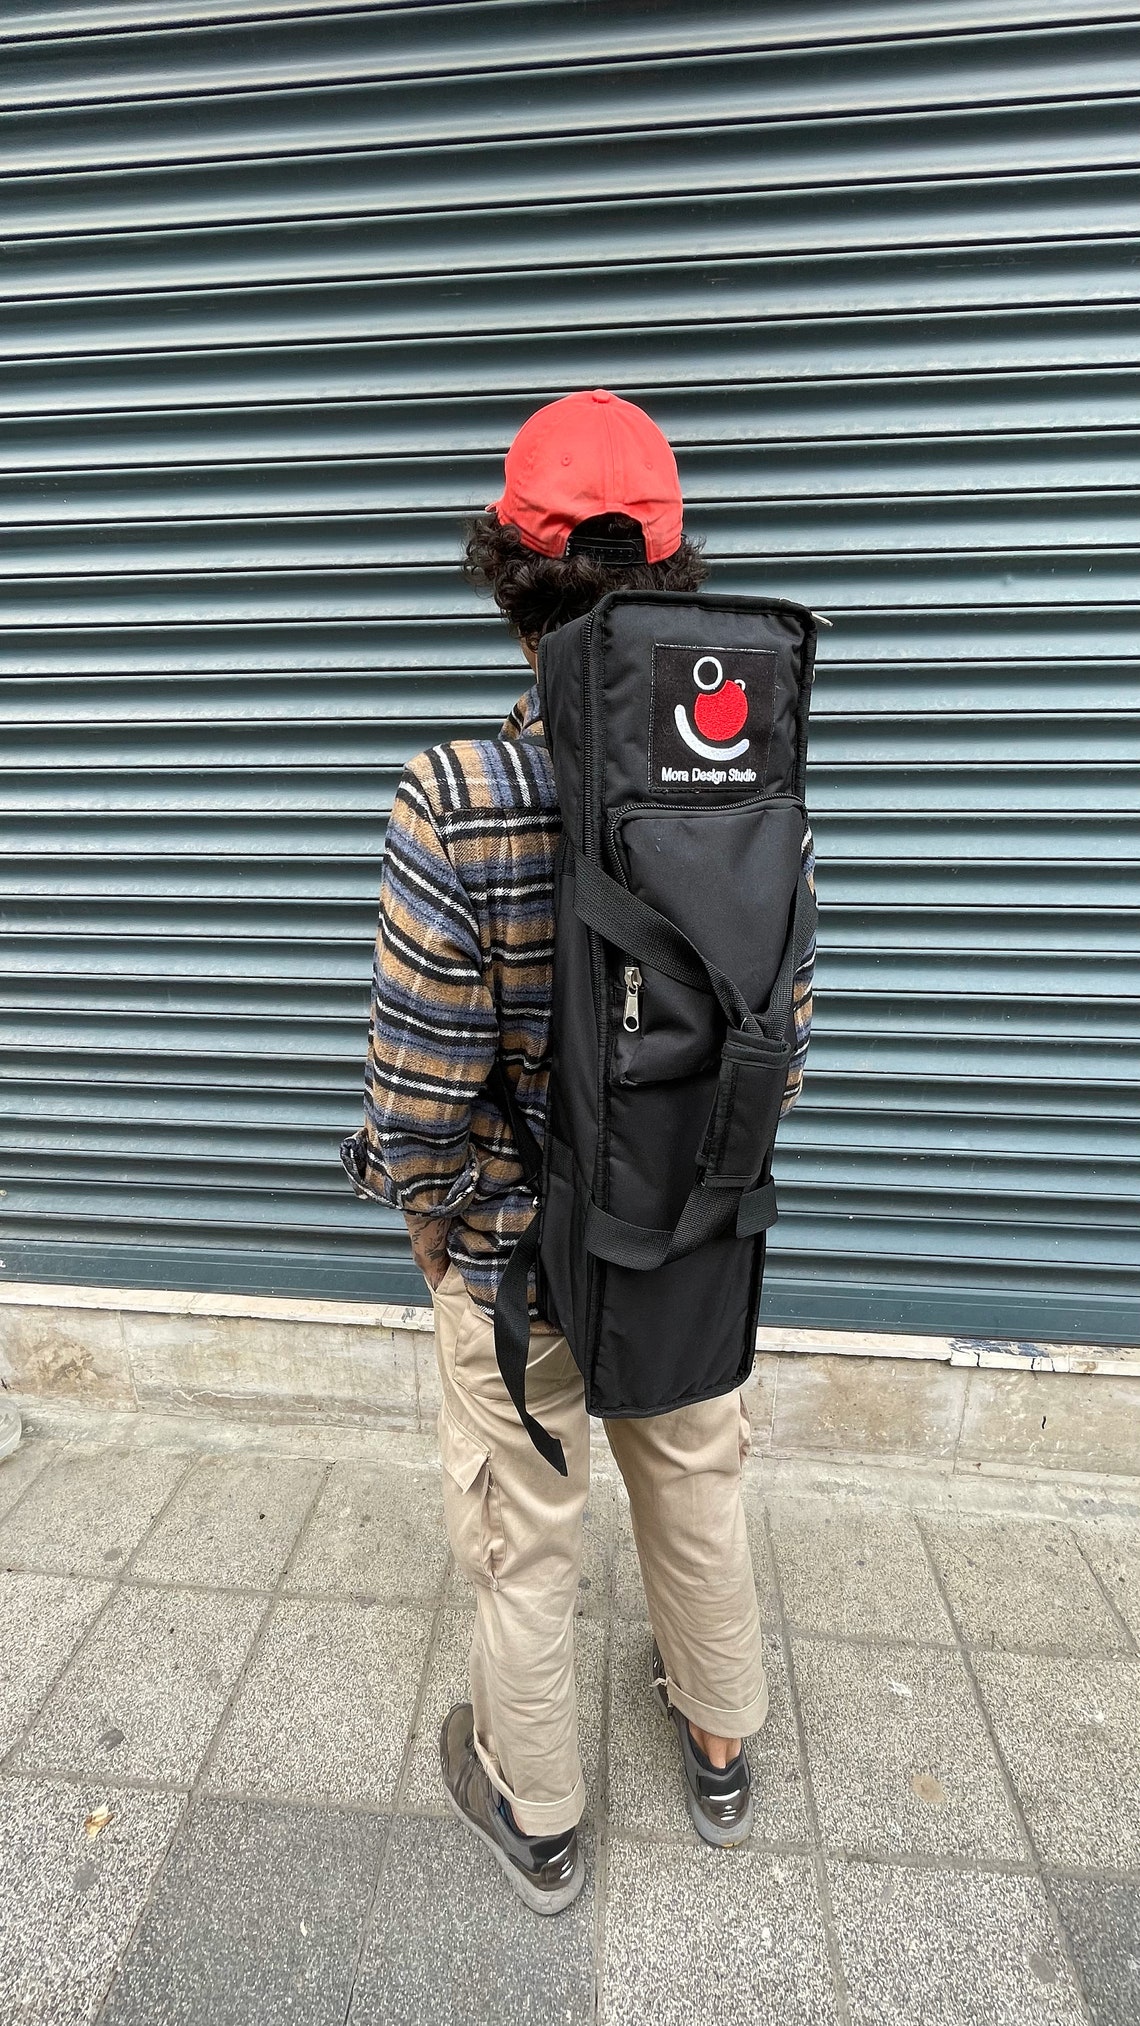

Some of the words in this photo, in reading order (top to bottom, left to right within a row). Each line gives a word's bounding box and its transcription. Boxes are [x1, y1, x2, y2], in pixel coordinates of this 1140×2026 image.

[661, 767, 689, 782] Mora
[692, 767, 727, 785] Design
[728, 768, 757, 782] Studio
